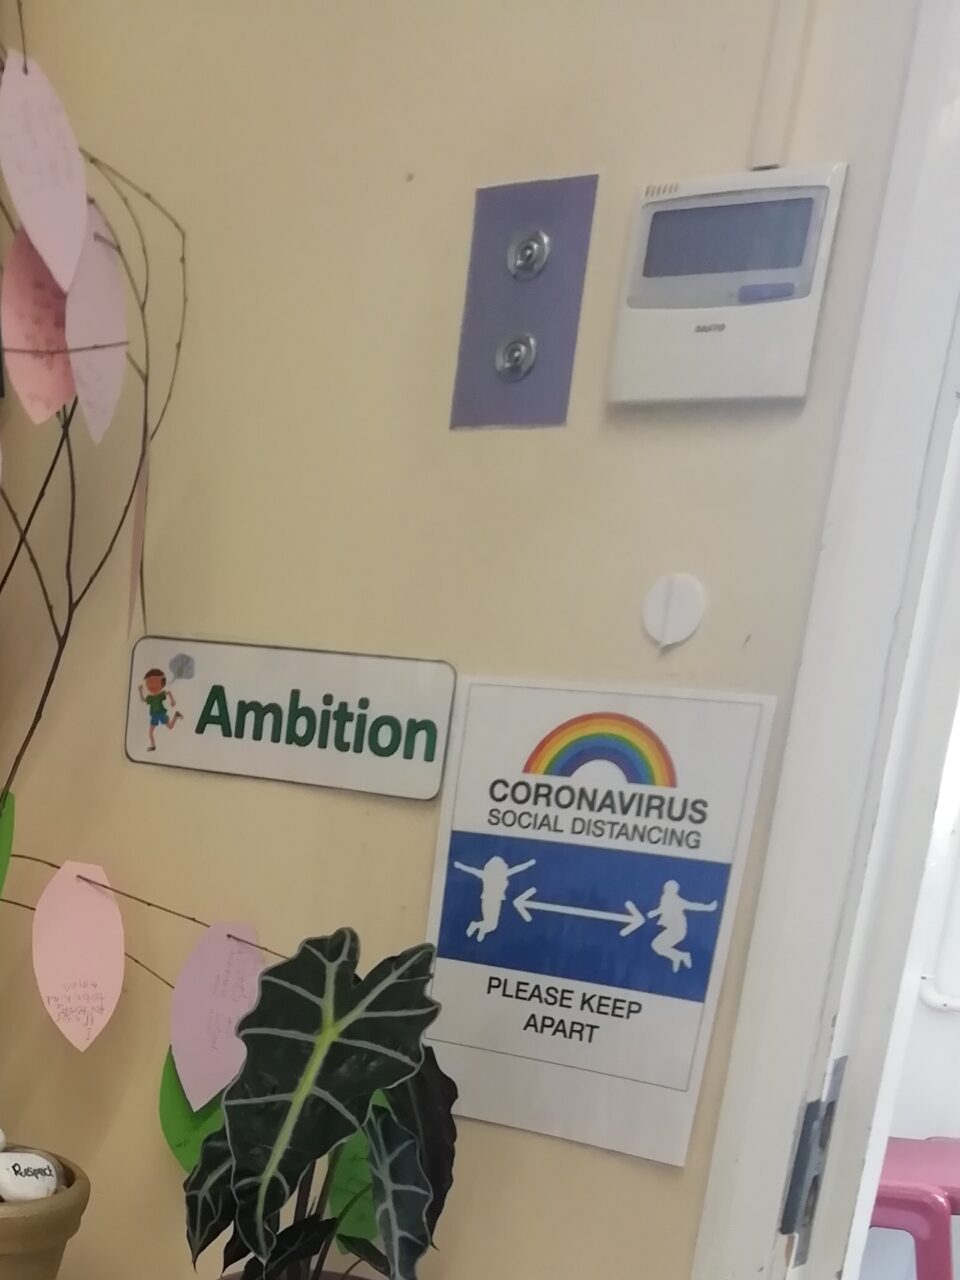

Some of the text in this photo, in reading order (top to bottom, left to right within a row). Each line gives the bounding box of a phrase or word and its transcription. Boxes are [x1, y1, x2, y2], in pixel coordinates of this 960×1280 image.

[195, 684, 437, 762] Ambition
[489, 778, 708, 825] CORONAVIRUS
[488, 808, 702, 850] SOCIAL DISTANCING
[486, 975, 643, 1021] PLEASE KEEP
[523, 1013, 601, 1044] APART
